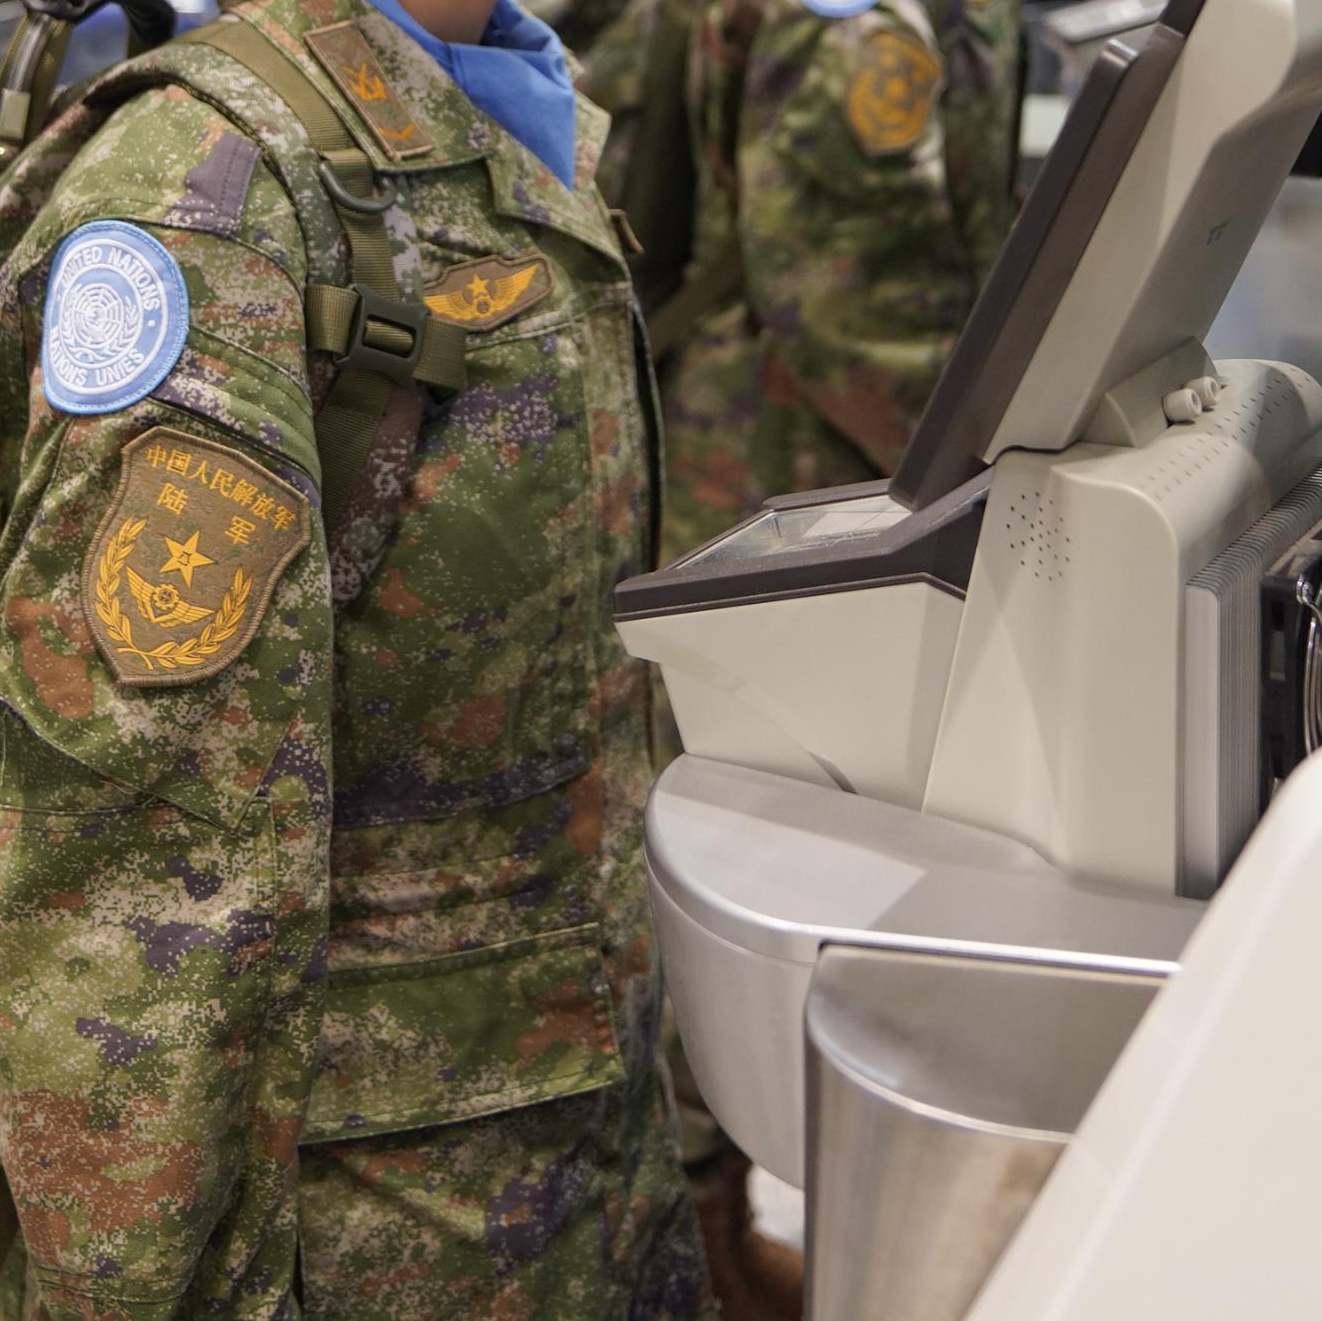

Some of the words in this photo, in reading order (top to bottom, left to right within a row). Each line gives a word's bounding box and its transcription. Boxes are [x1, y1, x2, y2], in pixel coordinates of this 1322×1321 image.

[107, 247, 161, 310] NATIONS
[146, 444, 296, 530] 中国人民解放军
